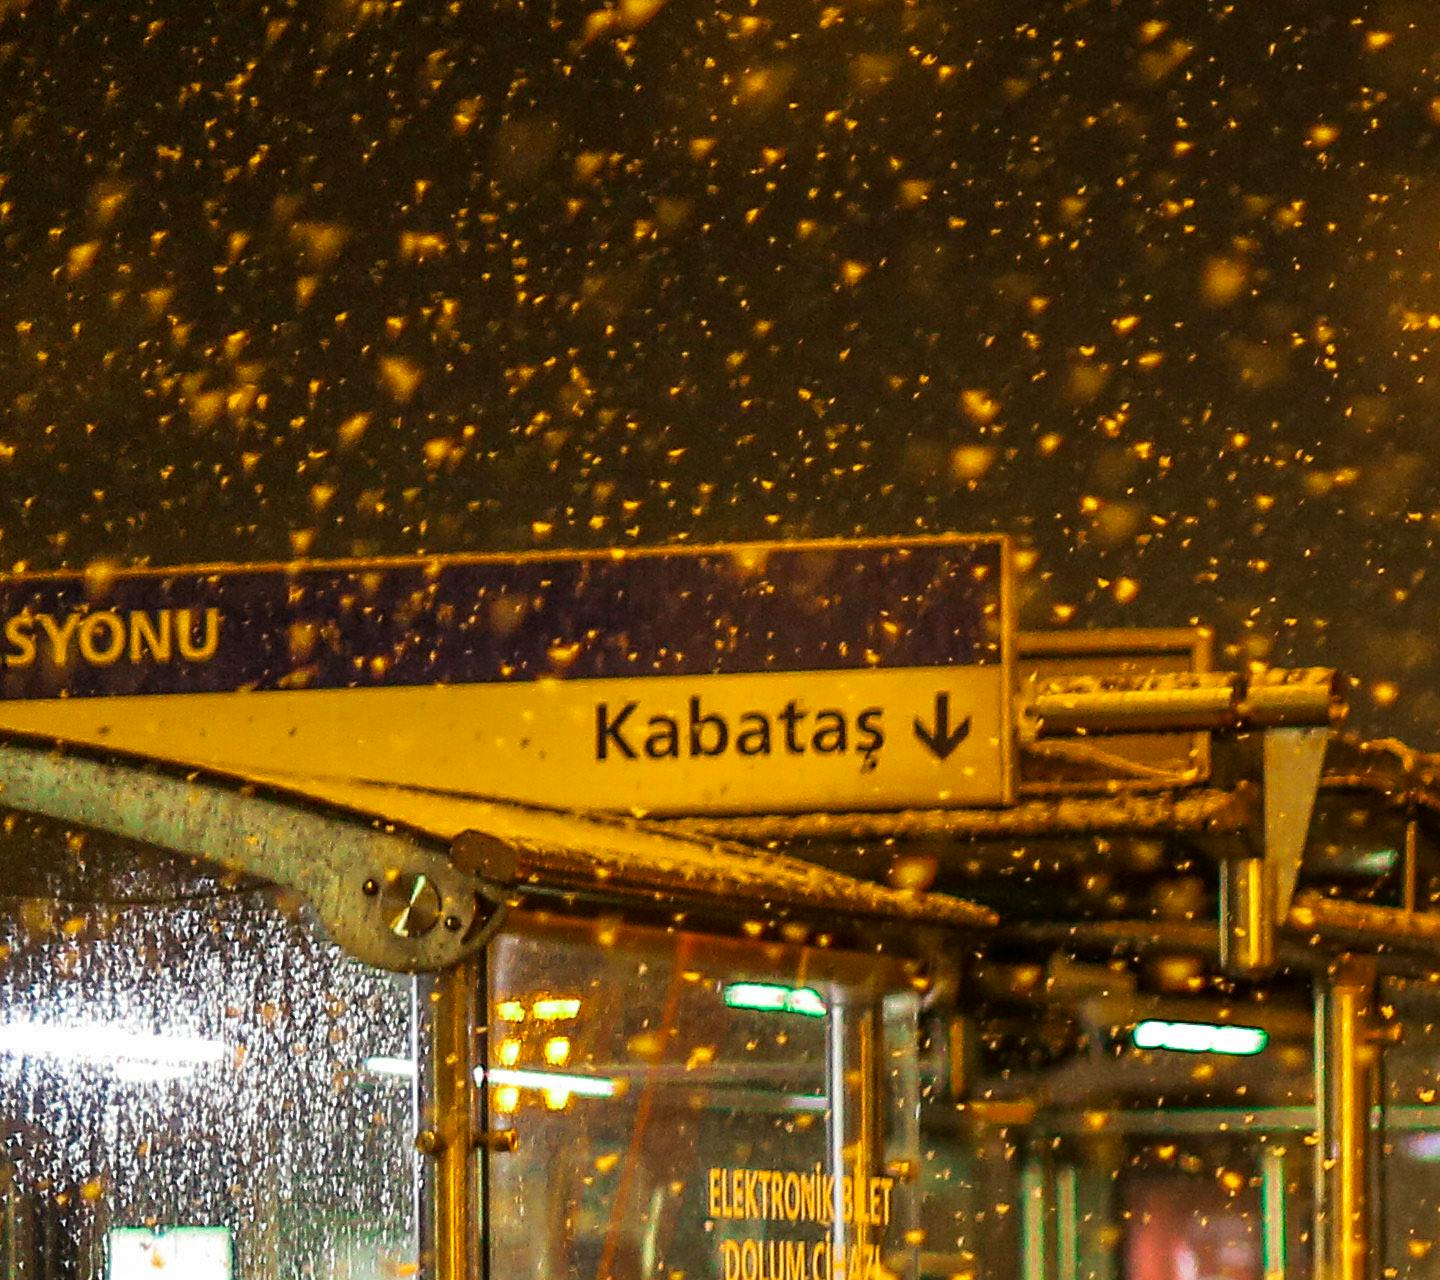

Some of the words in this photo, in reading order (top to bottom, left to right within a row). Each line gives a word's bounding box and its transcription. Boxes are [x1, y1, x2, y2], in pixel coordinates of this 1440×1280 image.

[5, 607, 221, 666] SYONU
[595, 696, 886, 774] Kabataş
[709, 1163, 835, 1222] ELEKTRONİK
